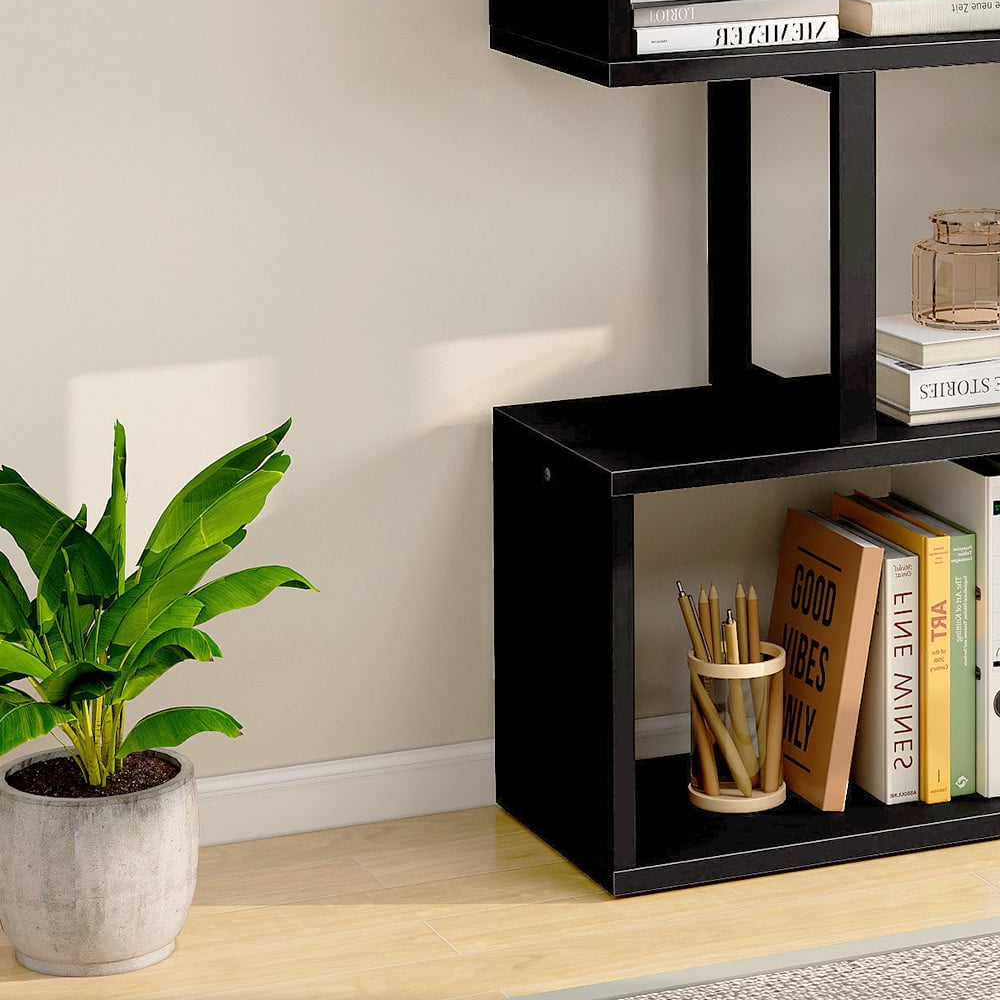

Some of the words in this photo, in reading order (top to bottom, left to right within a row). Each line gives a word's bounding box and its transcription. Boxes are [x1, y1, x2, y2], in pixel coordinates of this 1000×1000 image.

[646, 6, 696, 24] LORIOT
[951, 3, 969, 14] Zeit
[971, 1, 993, 11] neue
[919, 377, 990, 400] STORIES
[790, 563, 837, 627] GOOD
[783, 622, 829, 693] VIBES
[783, 689, 817, 753] NLY
